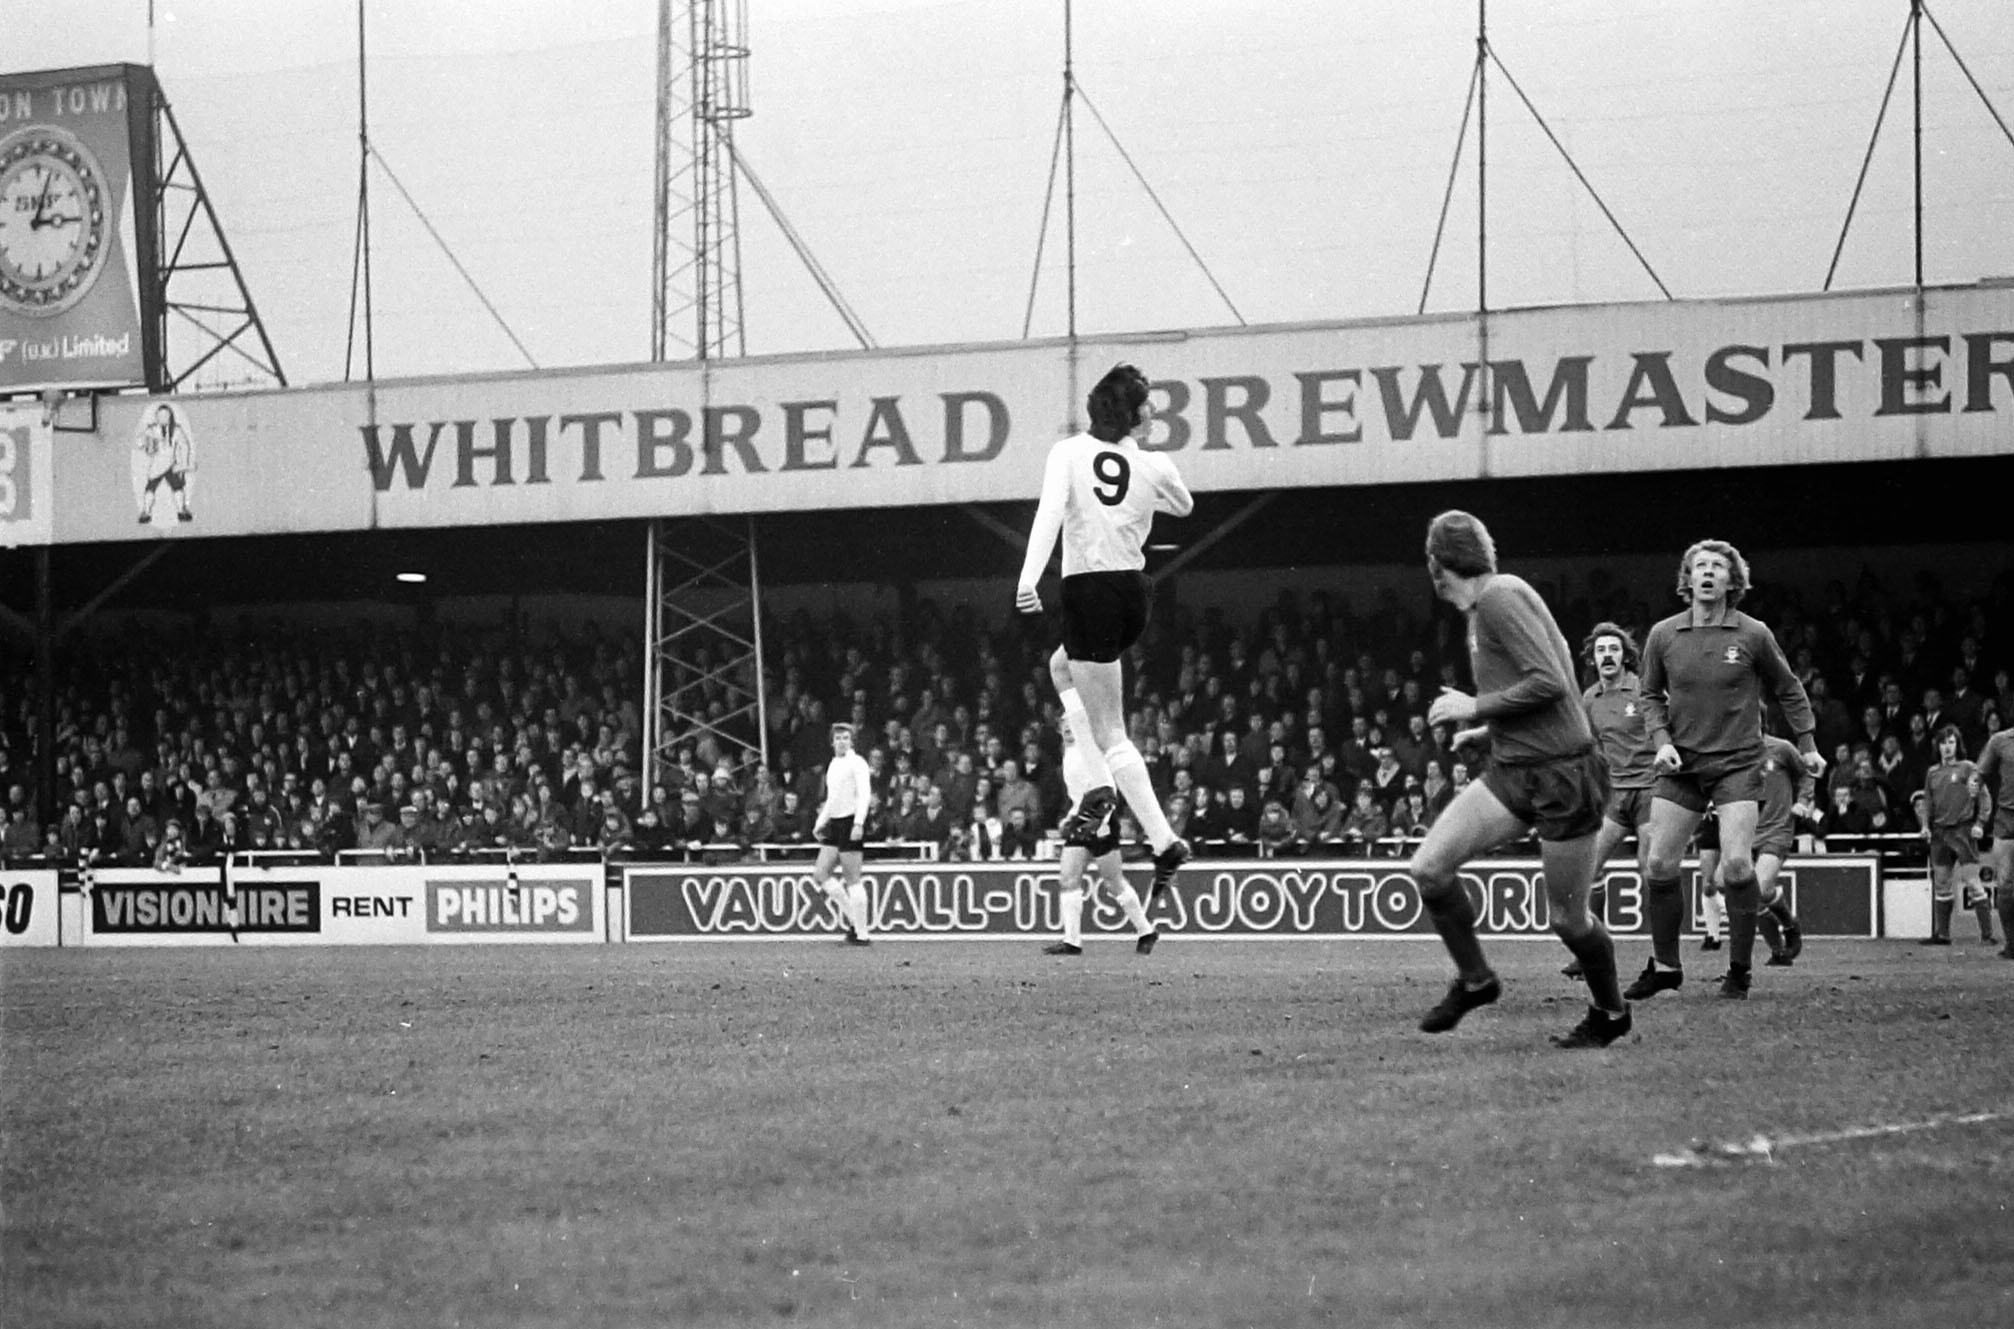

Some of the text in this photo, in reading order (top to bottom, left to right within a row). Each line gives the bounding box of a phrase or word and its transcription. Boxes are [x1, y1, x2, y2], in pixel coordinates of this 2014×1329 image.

[62, 332, 129, 359] Limited
[360, 331, 2014, 492] WHITBREAD BREWMASTER
[1093, 451, 1130, 506] 9
[102, 887, 579, 925] VISIONHIRE RENT PHILIPS
[1195, 872, 1327, 931] JOY
[1331, 873, 1423, 931] TO
[1456, 871, 1643, 932] RIE
